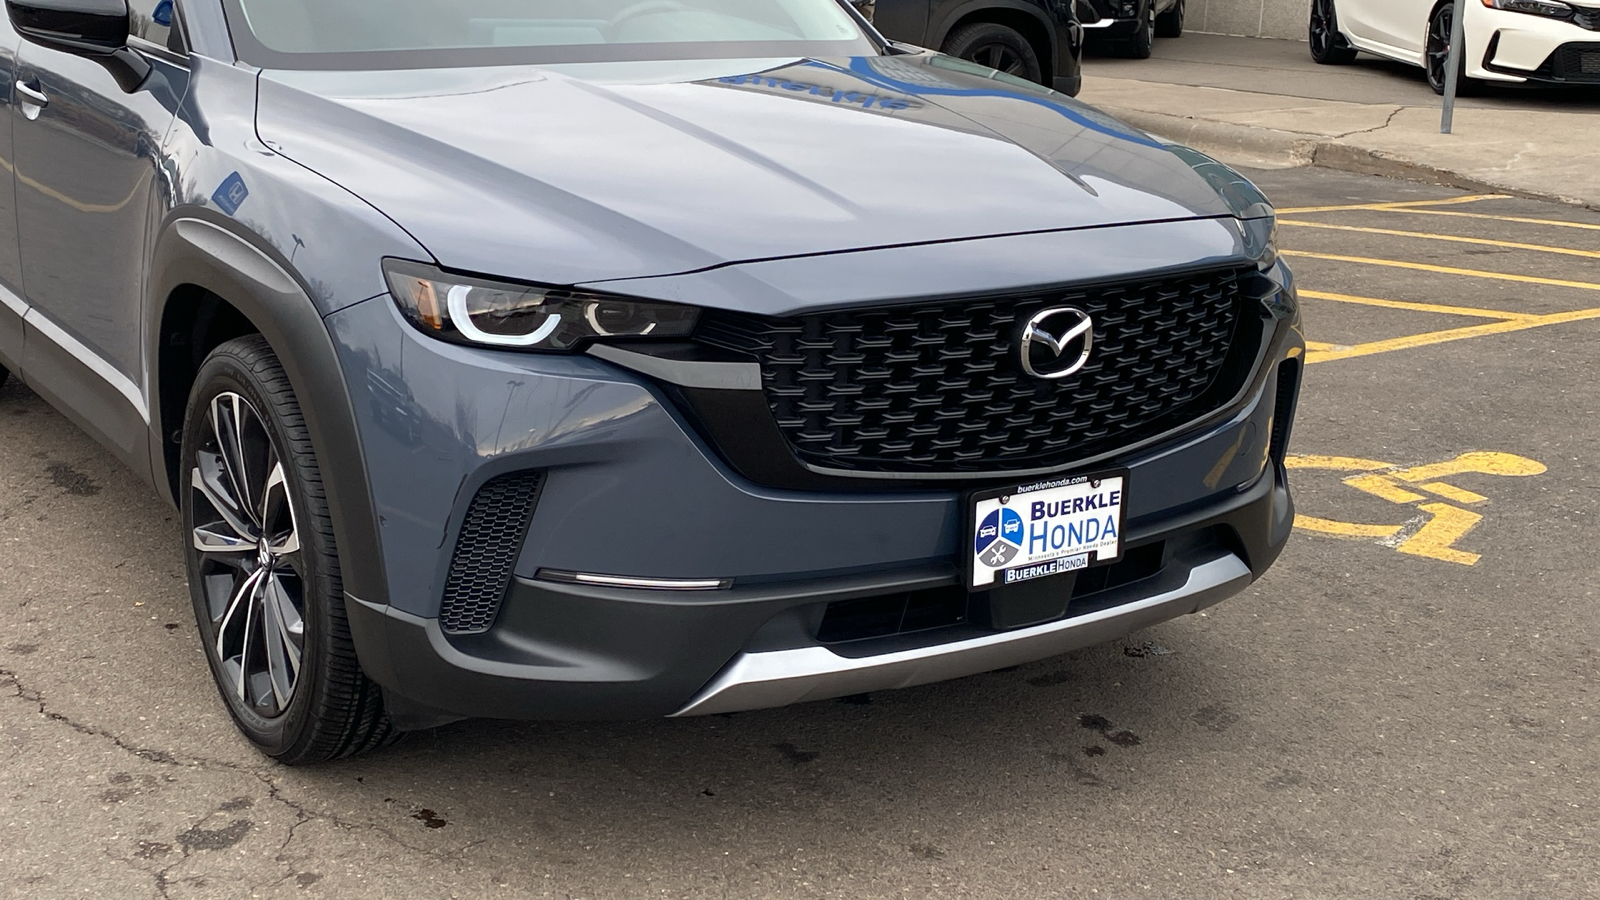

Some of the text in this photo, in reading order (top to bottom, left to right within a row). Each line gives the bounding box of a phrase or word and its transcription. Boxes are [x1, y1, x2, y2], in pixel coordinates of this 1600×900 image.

[1017, 476, 1088, 494] buerklehonda.com
[1031, 490, 1120, 521] BUERKLE
[1029, 514, 1117, 555] HONDA
[1083, 543, 1099, 551] Honda
[1007, 557, 1087, 582] BUERKLE HONDA
